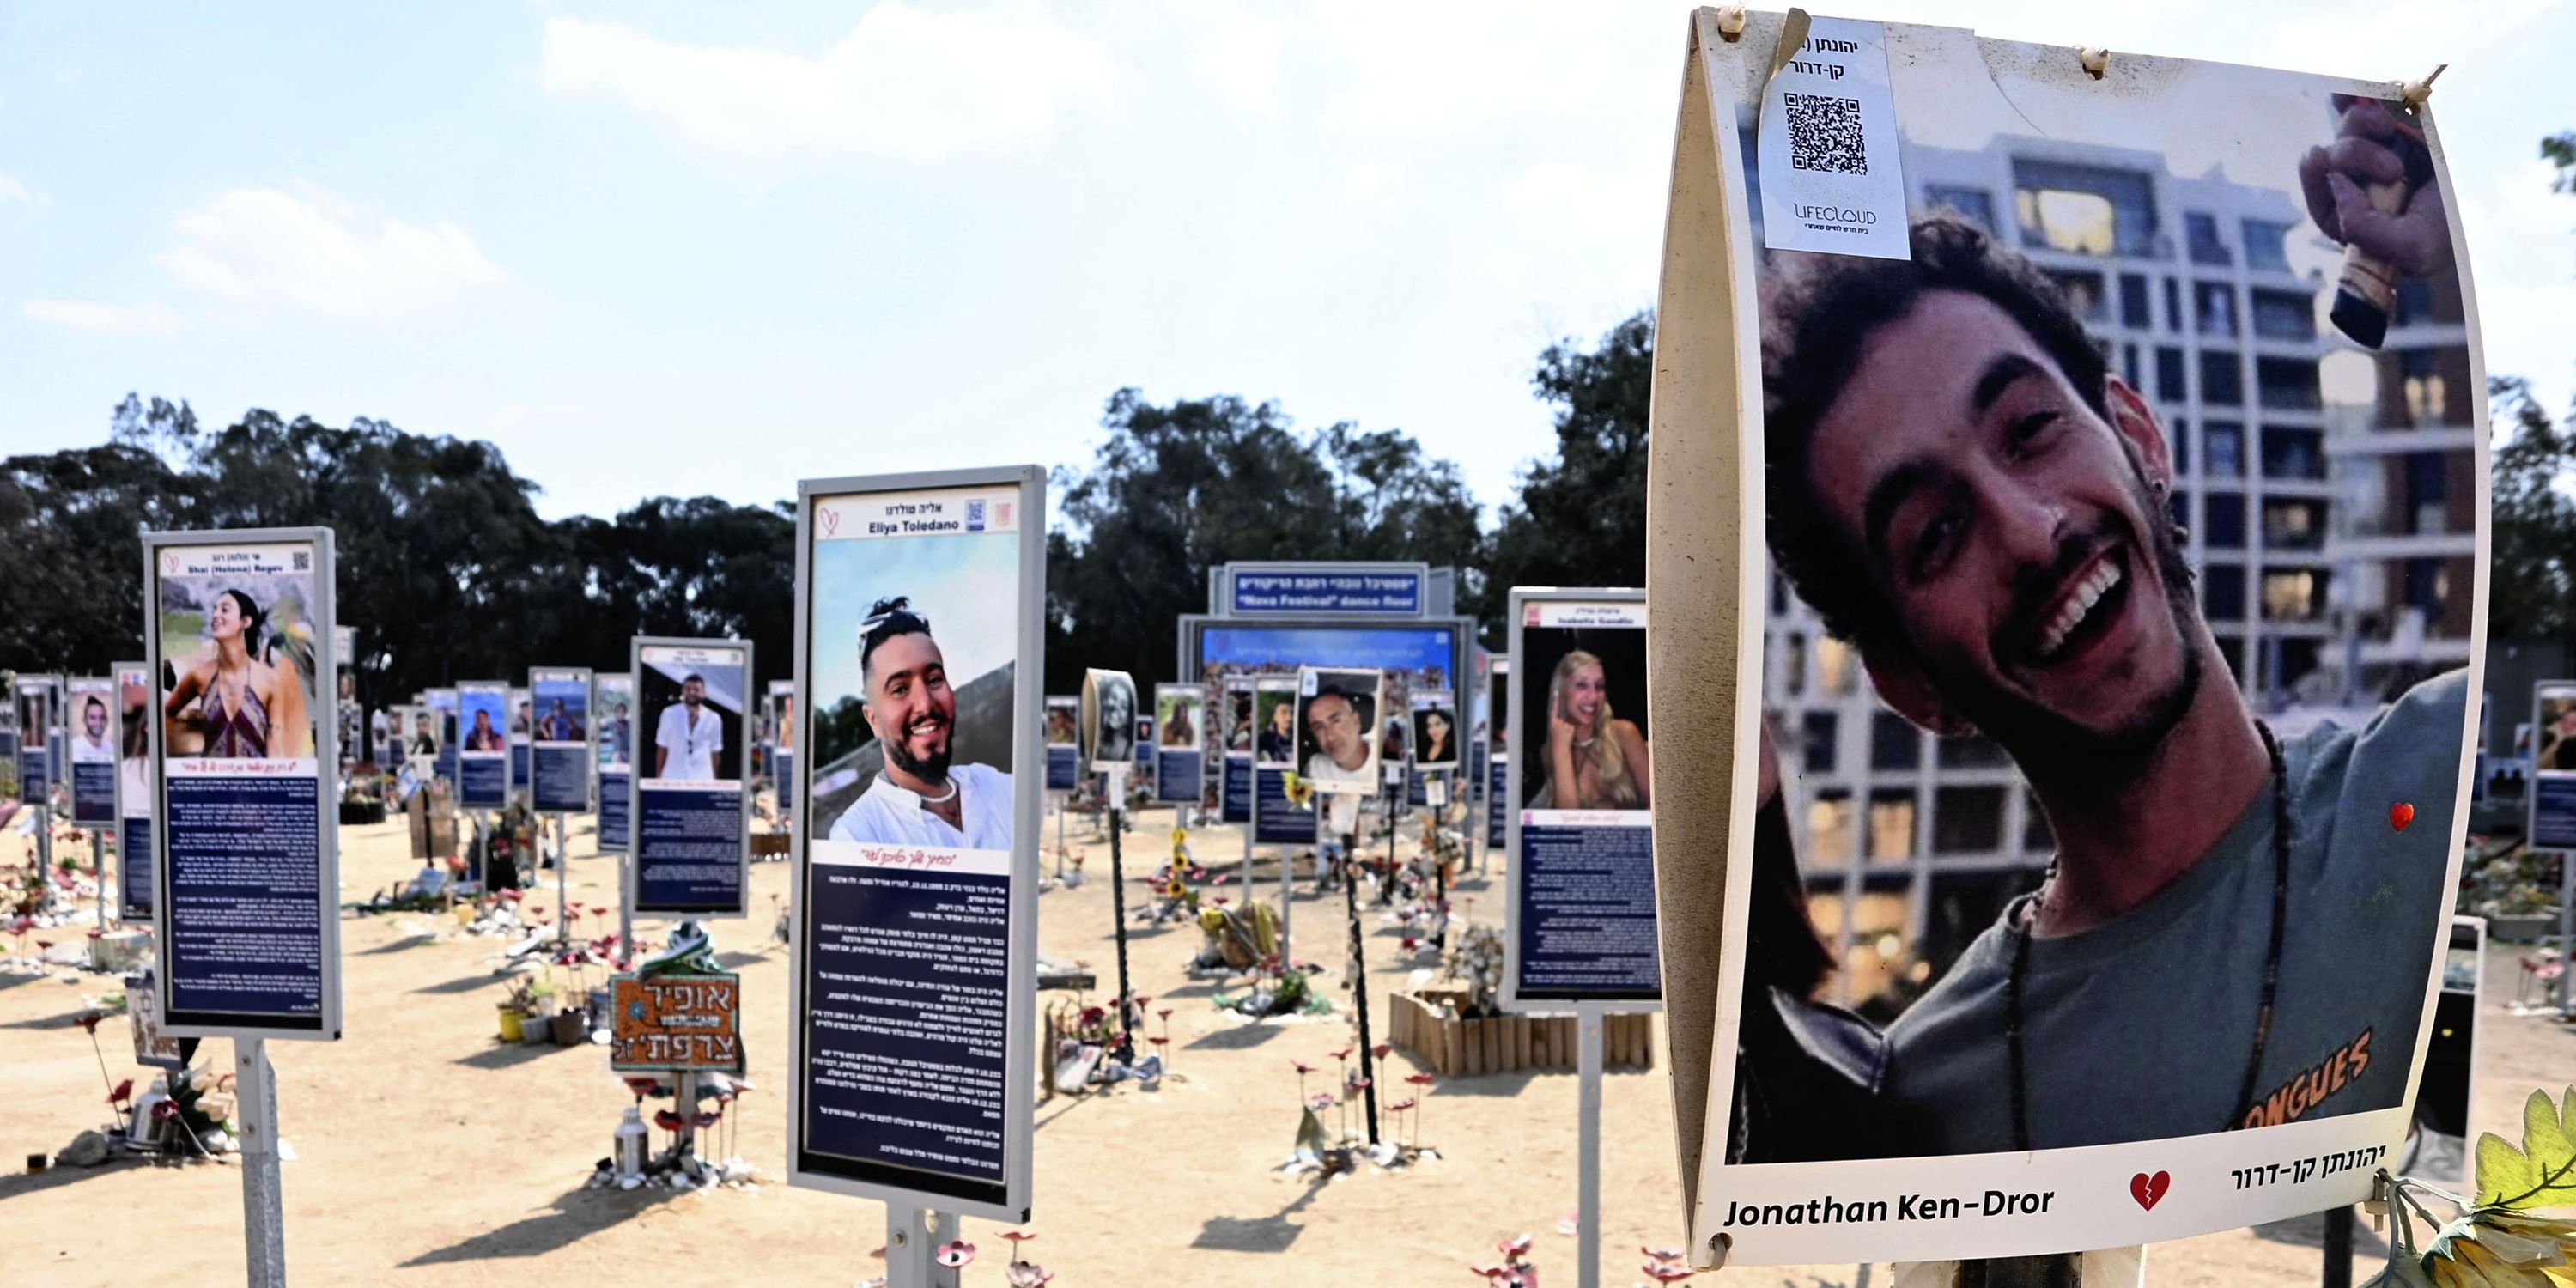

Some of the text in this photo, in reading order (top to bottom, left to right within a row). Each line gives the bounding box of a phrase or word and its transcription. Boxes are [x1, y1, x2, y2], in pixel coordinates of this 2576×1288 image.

[1815, 39, 1858, 53] יהונתן
[1789, 61, 1844, 80] קן-דרור
[1794, 203, 1876, 224] LIFECLOUD
[885, 502, 942, 515] אליה טולדנו
[869, 519, 959, 536] Eliya Toledano
[644, 985, 731, 1011] אופיר
[639, 1034, 734, 1060] צרפתי
[2228, 1030, 2371, 1132] ONGUES
[2231, 1145, 2386, 1190] יהונתן קן-דרור
[1722, 1189, 2056, 1228] Jonathan Ken-Dror
